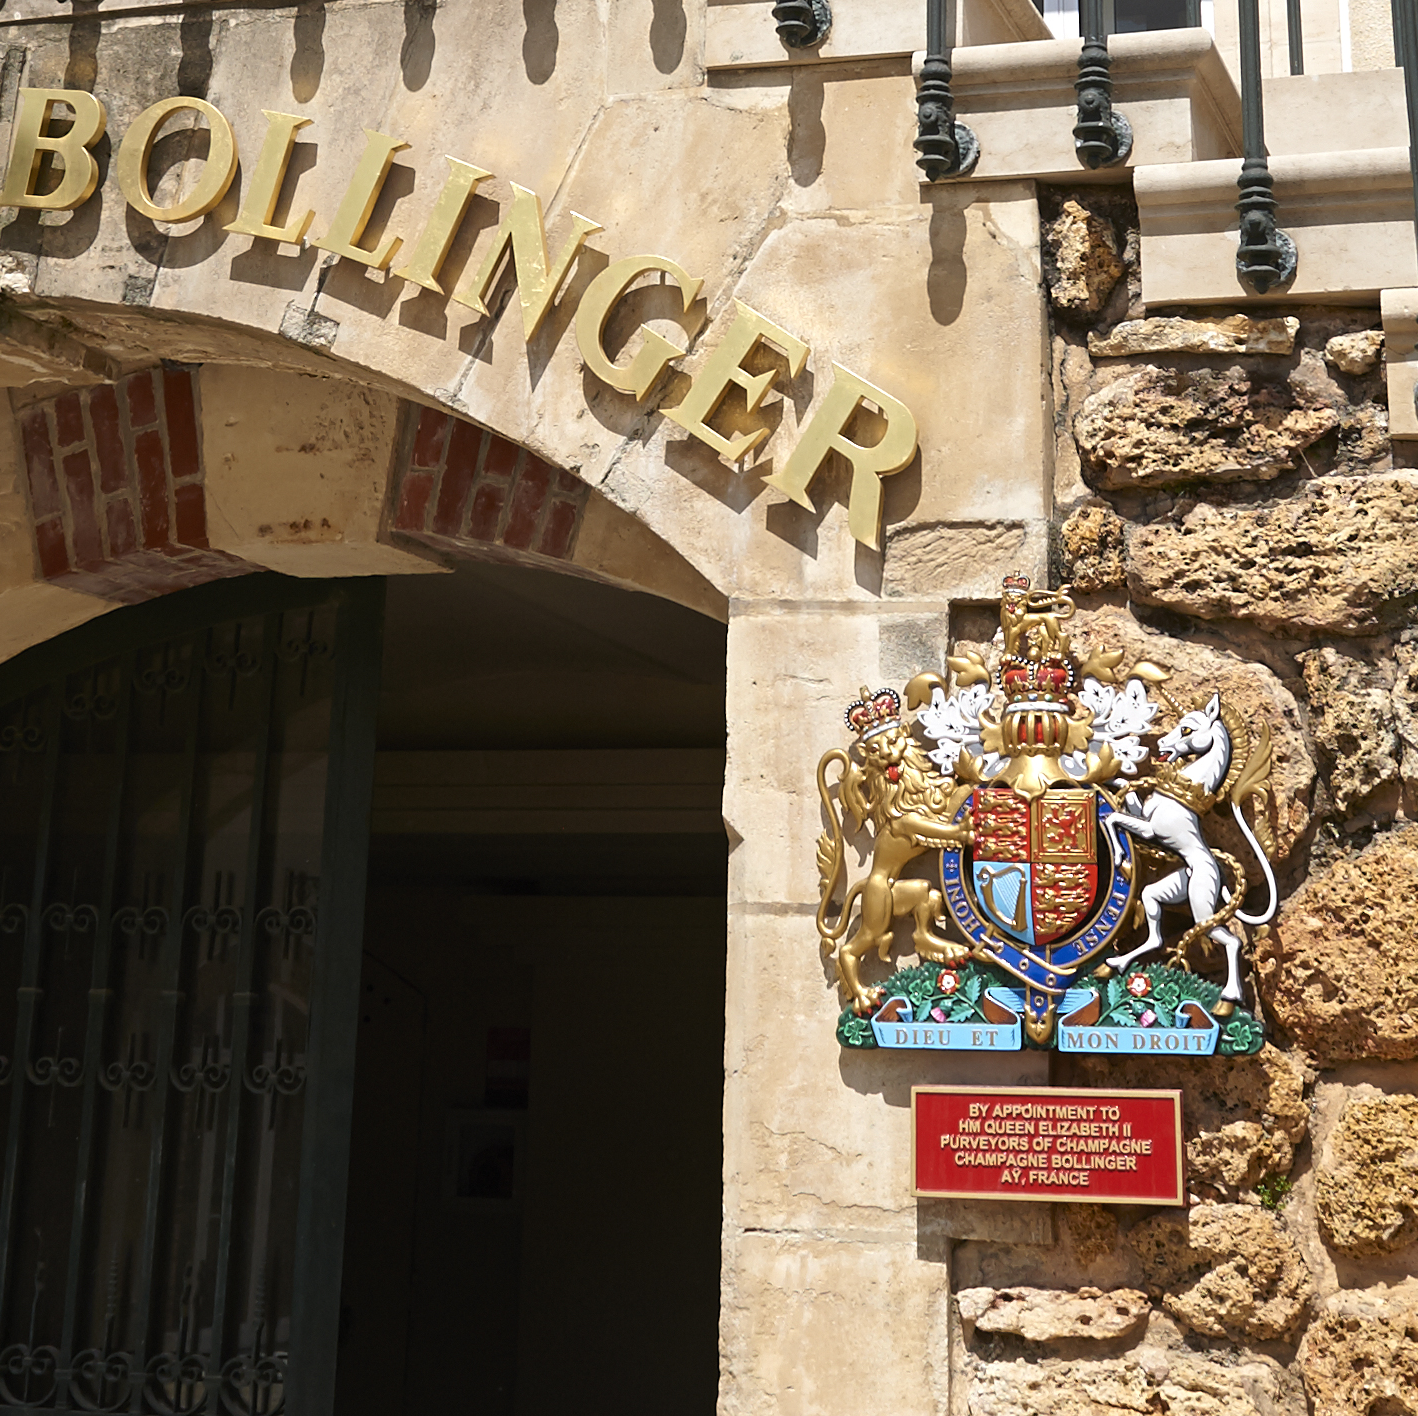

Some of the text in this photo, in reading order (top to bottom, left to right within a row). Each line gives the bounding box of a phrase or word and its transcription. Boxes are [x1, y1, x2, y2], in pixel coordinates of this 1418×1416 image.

[945, 878, 980, 933] HONI
[1072, 891, 1126, 956] PENSE
[894, 1028, 1206, 1051] DIEU ET MON DROIT
[969, 1103, 1120, 1121] BY APPOINTMENT TO
[959, 1119, 1132, 1137] HM QUEEN ELIZABETH II
[940, 1135, 1152, 1154] PURVEYORS OF CHAMPAGNE
[955, 1151, 1137, 1171] CHAMPAGNE BOLLINGER
[1029, 1170, 1090, 1186] FRANCE
